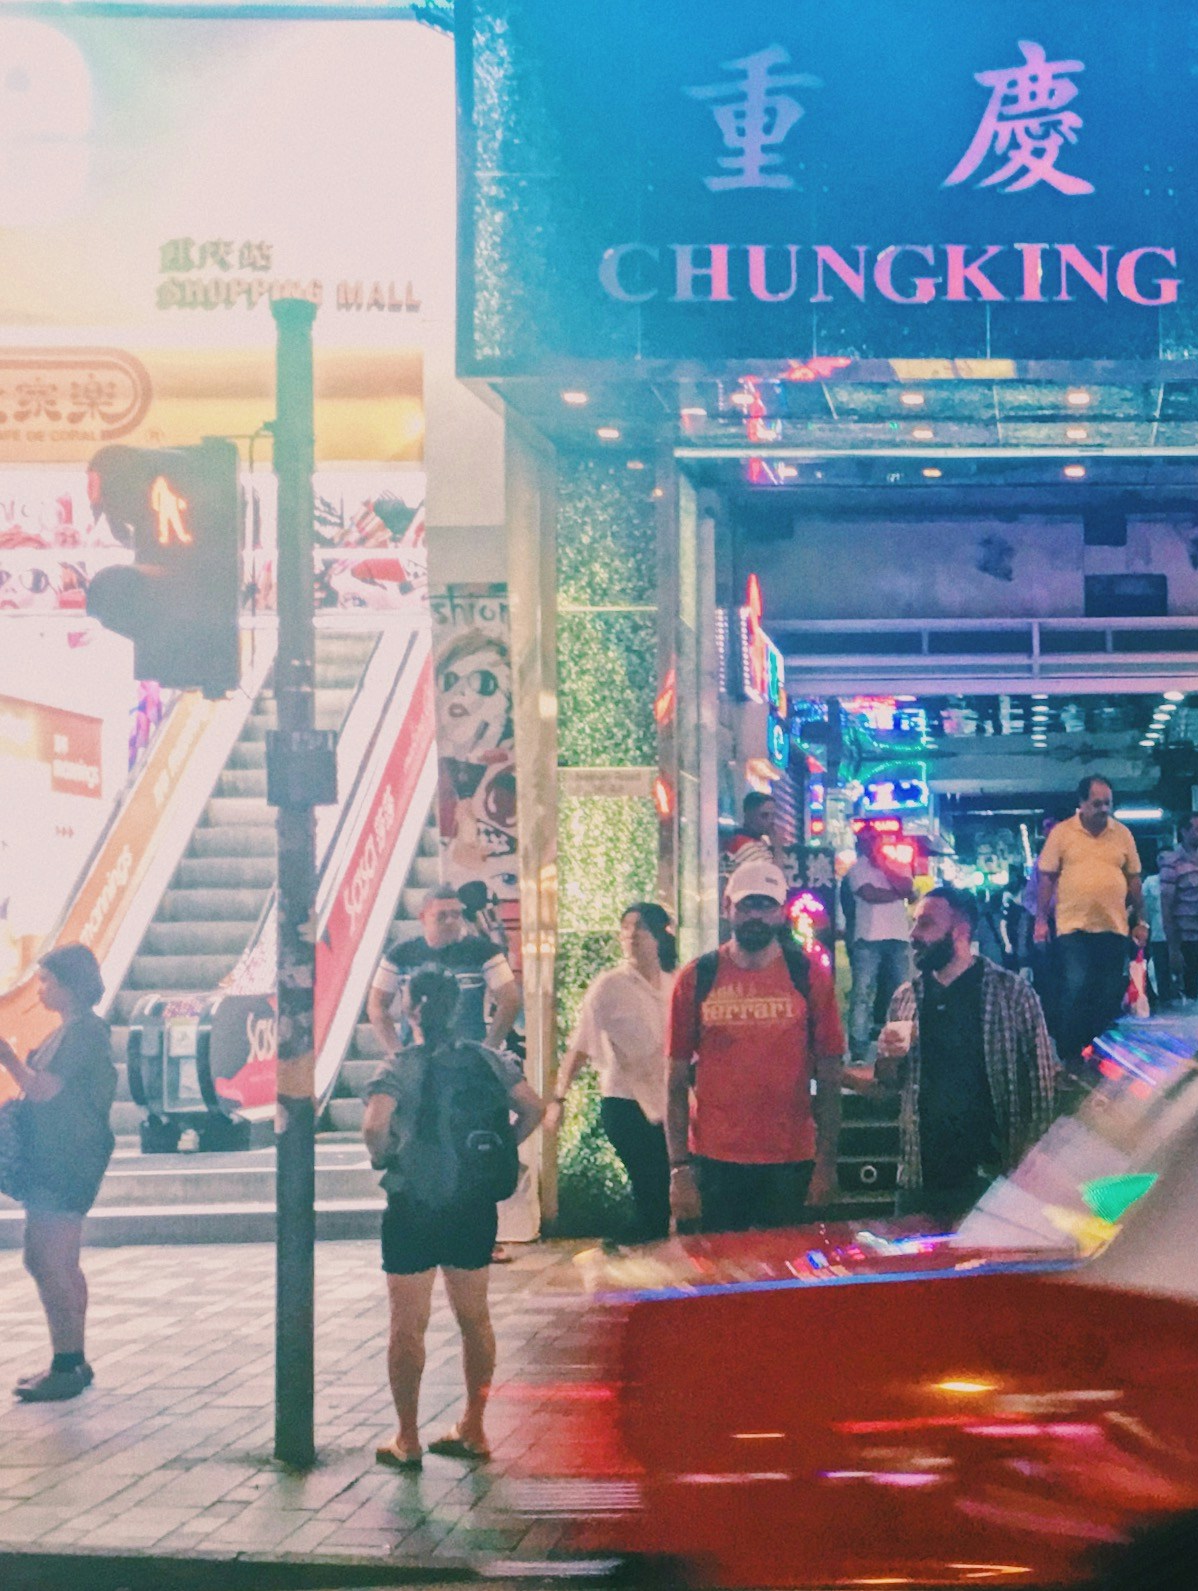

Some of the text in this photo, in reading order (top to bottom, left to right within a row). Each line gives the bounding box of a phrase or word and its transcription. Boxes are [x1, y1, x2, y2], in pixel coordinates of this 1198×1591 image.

[156, 277, 421, 312] SHOPPING MALL
[600, 243, 1179, 305] CHUNGKING
